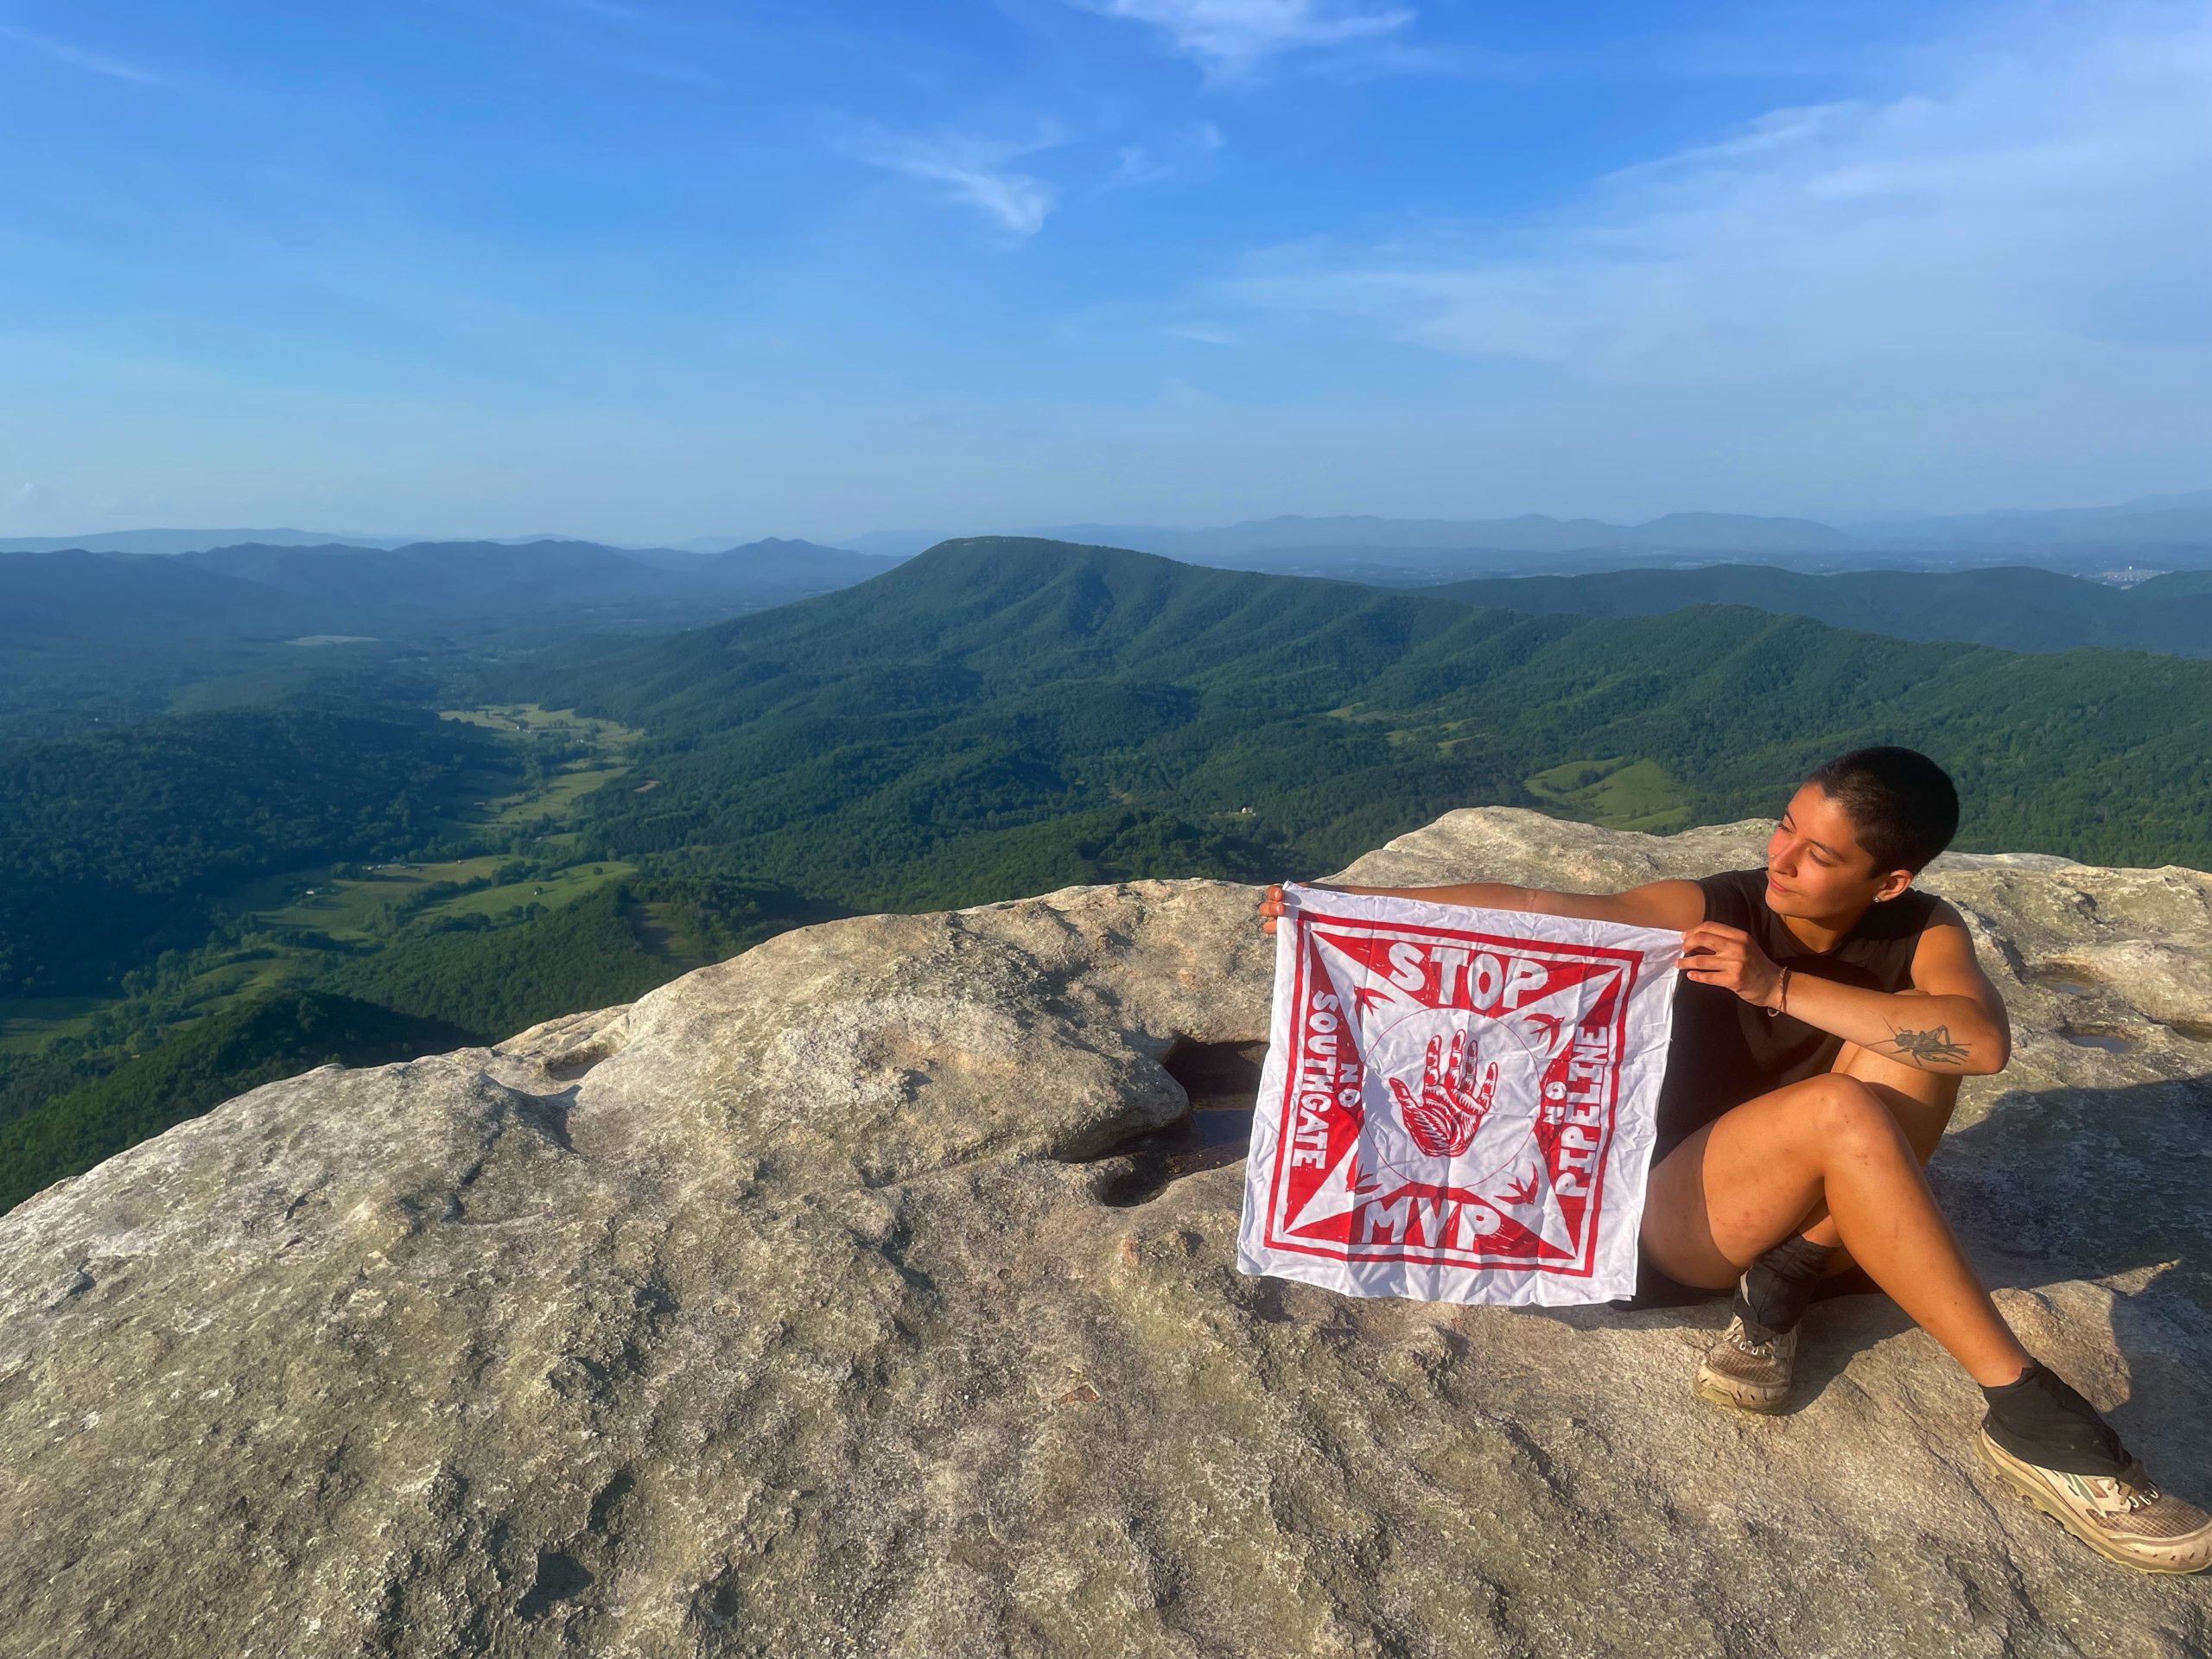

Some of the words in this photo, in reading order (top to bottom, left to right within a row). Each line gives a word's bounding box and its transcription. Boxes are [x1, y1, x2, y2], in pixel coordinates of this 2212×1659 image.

[1389, 942, 1549, 1010] STOP
[1292, 990, 1338, 1169] SOUTHGATE
[1337, 1063, 1361, 1108] NO
[1542, 1080, 1567, 1125] NO
[1555, 1026, 1608, 1197] PIPELINE
[1363, 1196, 1502, 1249] MVP
